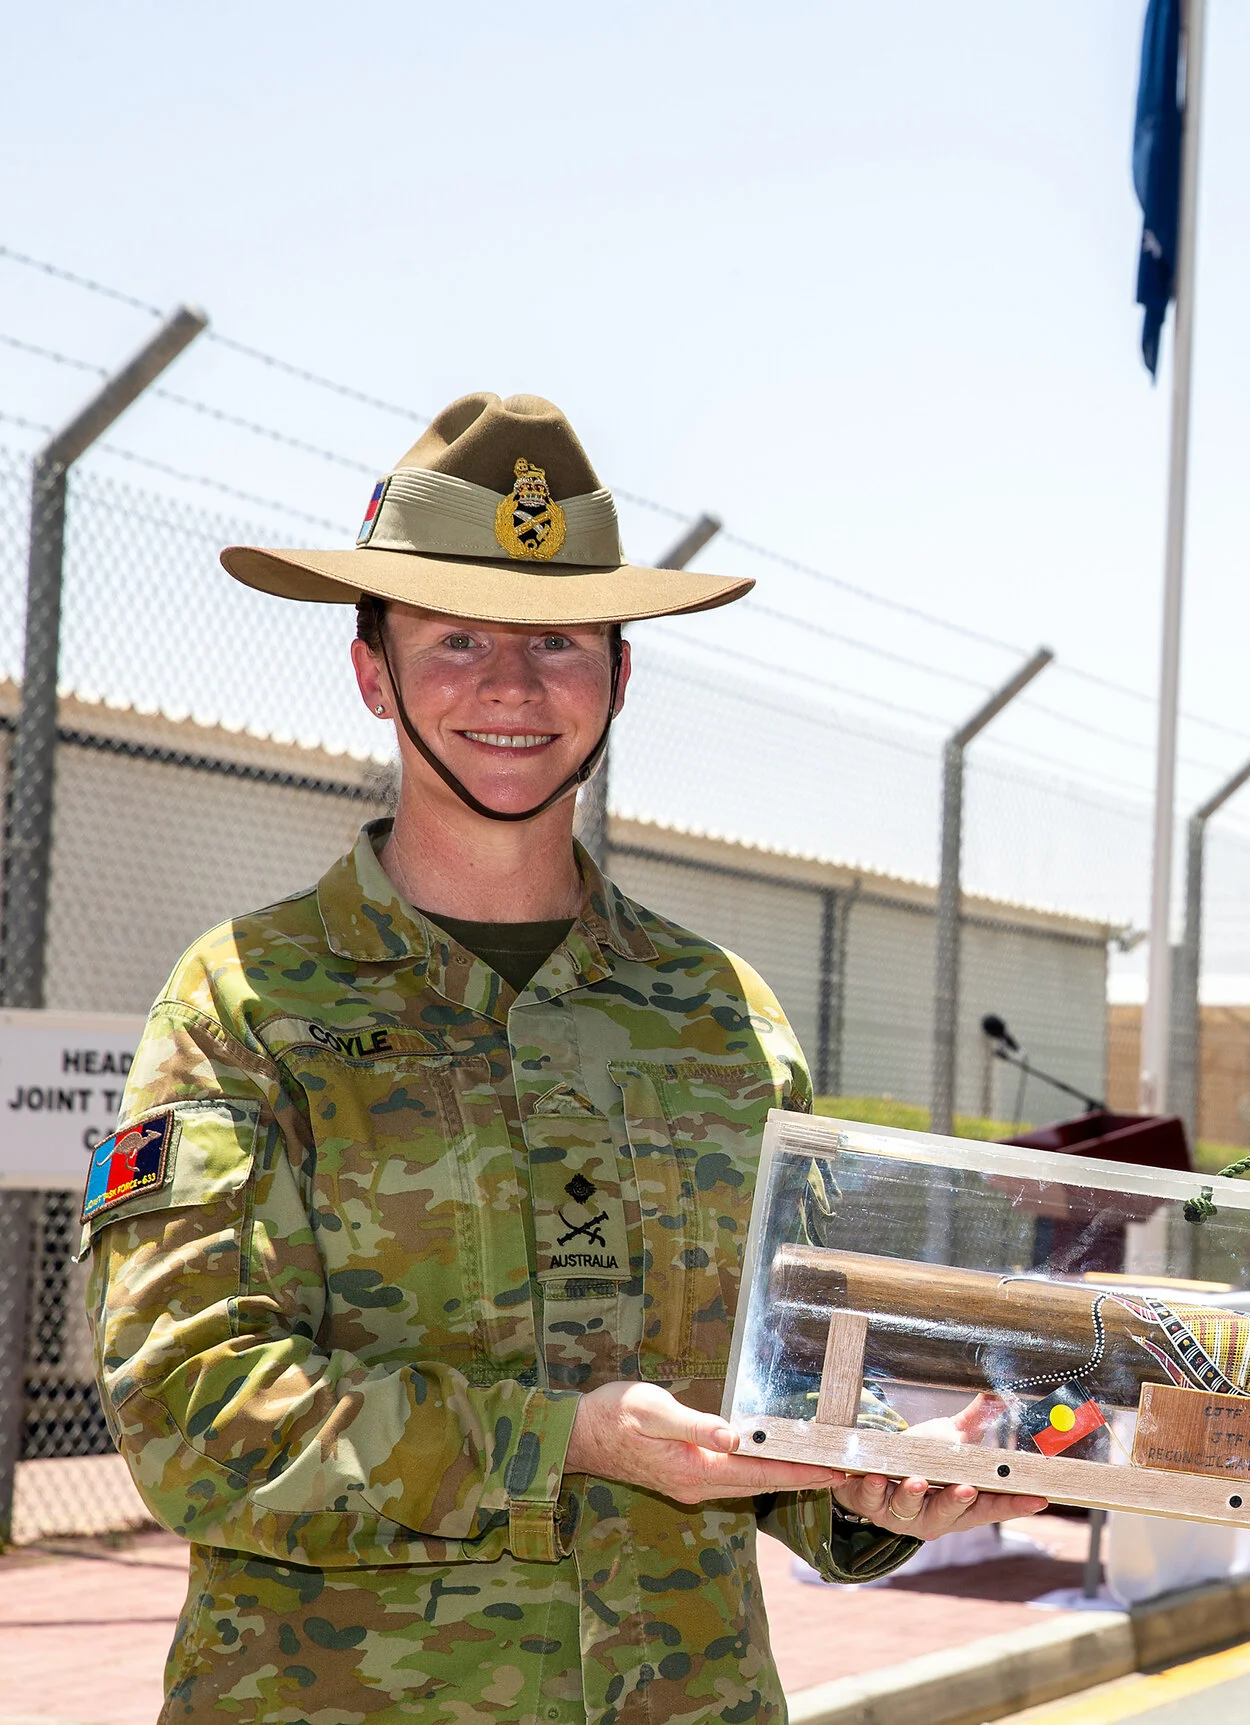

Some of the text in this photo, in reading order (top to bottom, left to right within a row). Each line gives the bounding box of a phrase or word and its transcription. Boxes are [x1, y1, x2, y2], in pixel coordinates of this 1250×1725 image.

[308, 1024, 393, 1057] COYLE
[9, 1087, 124, 1113] JOINT T
[549, 1254, 619, 1269] AUSTRALIA
[1204, 1405, 1243, 1419] CJTF
[1211, 1432, 1244, 1446] JTF
